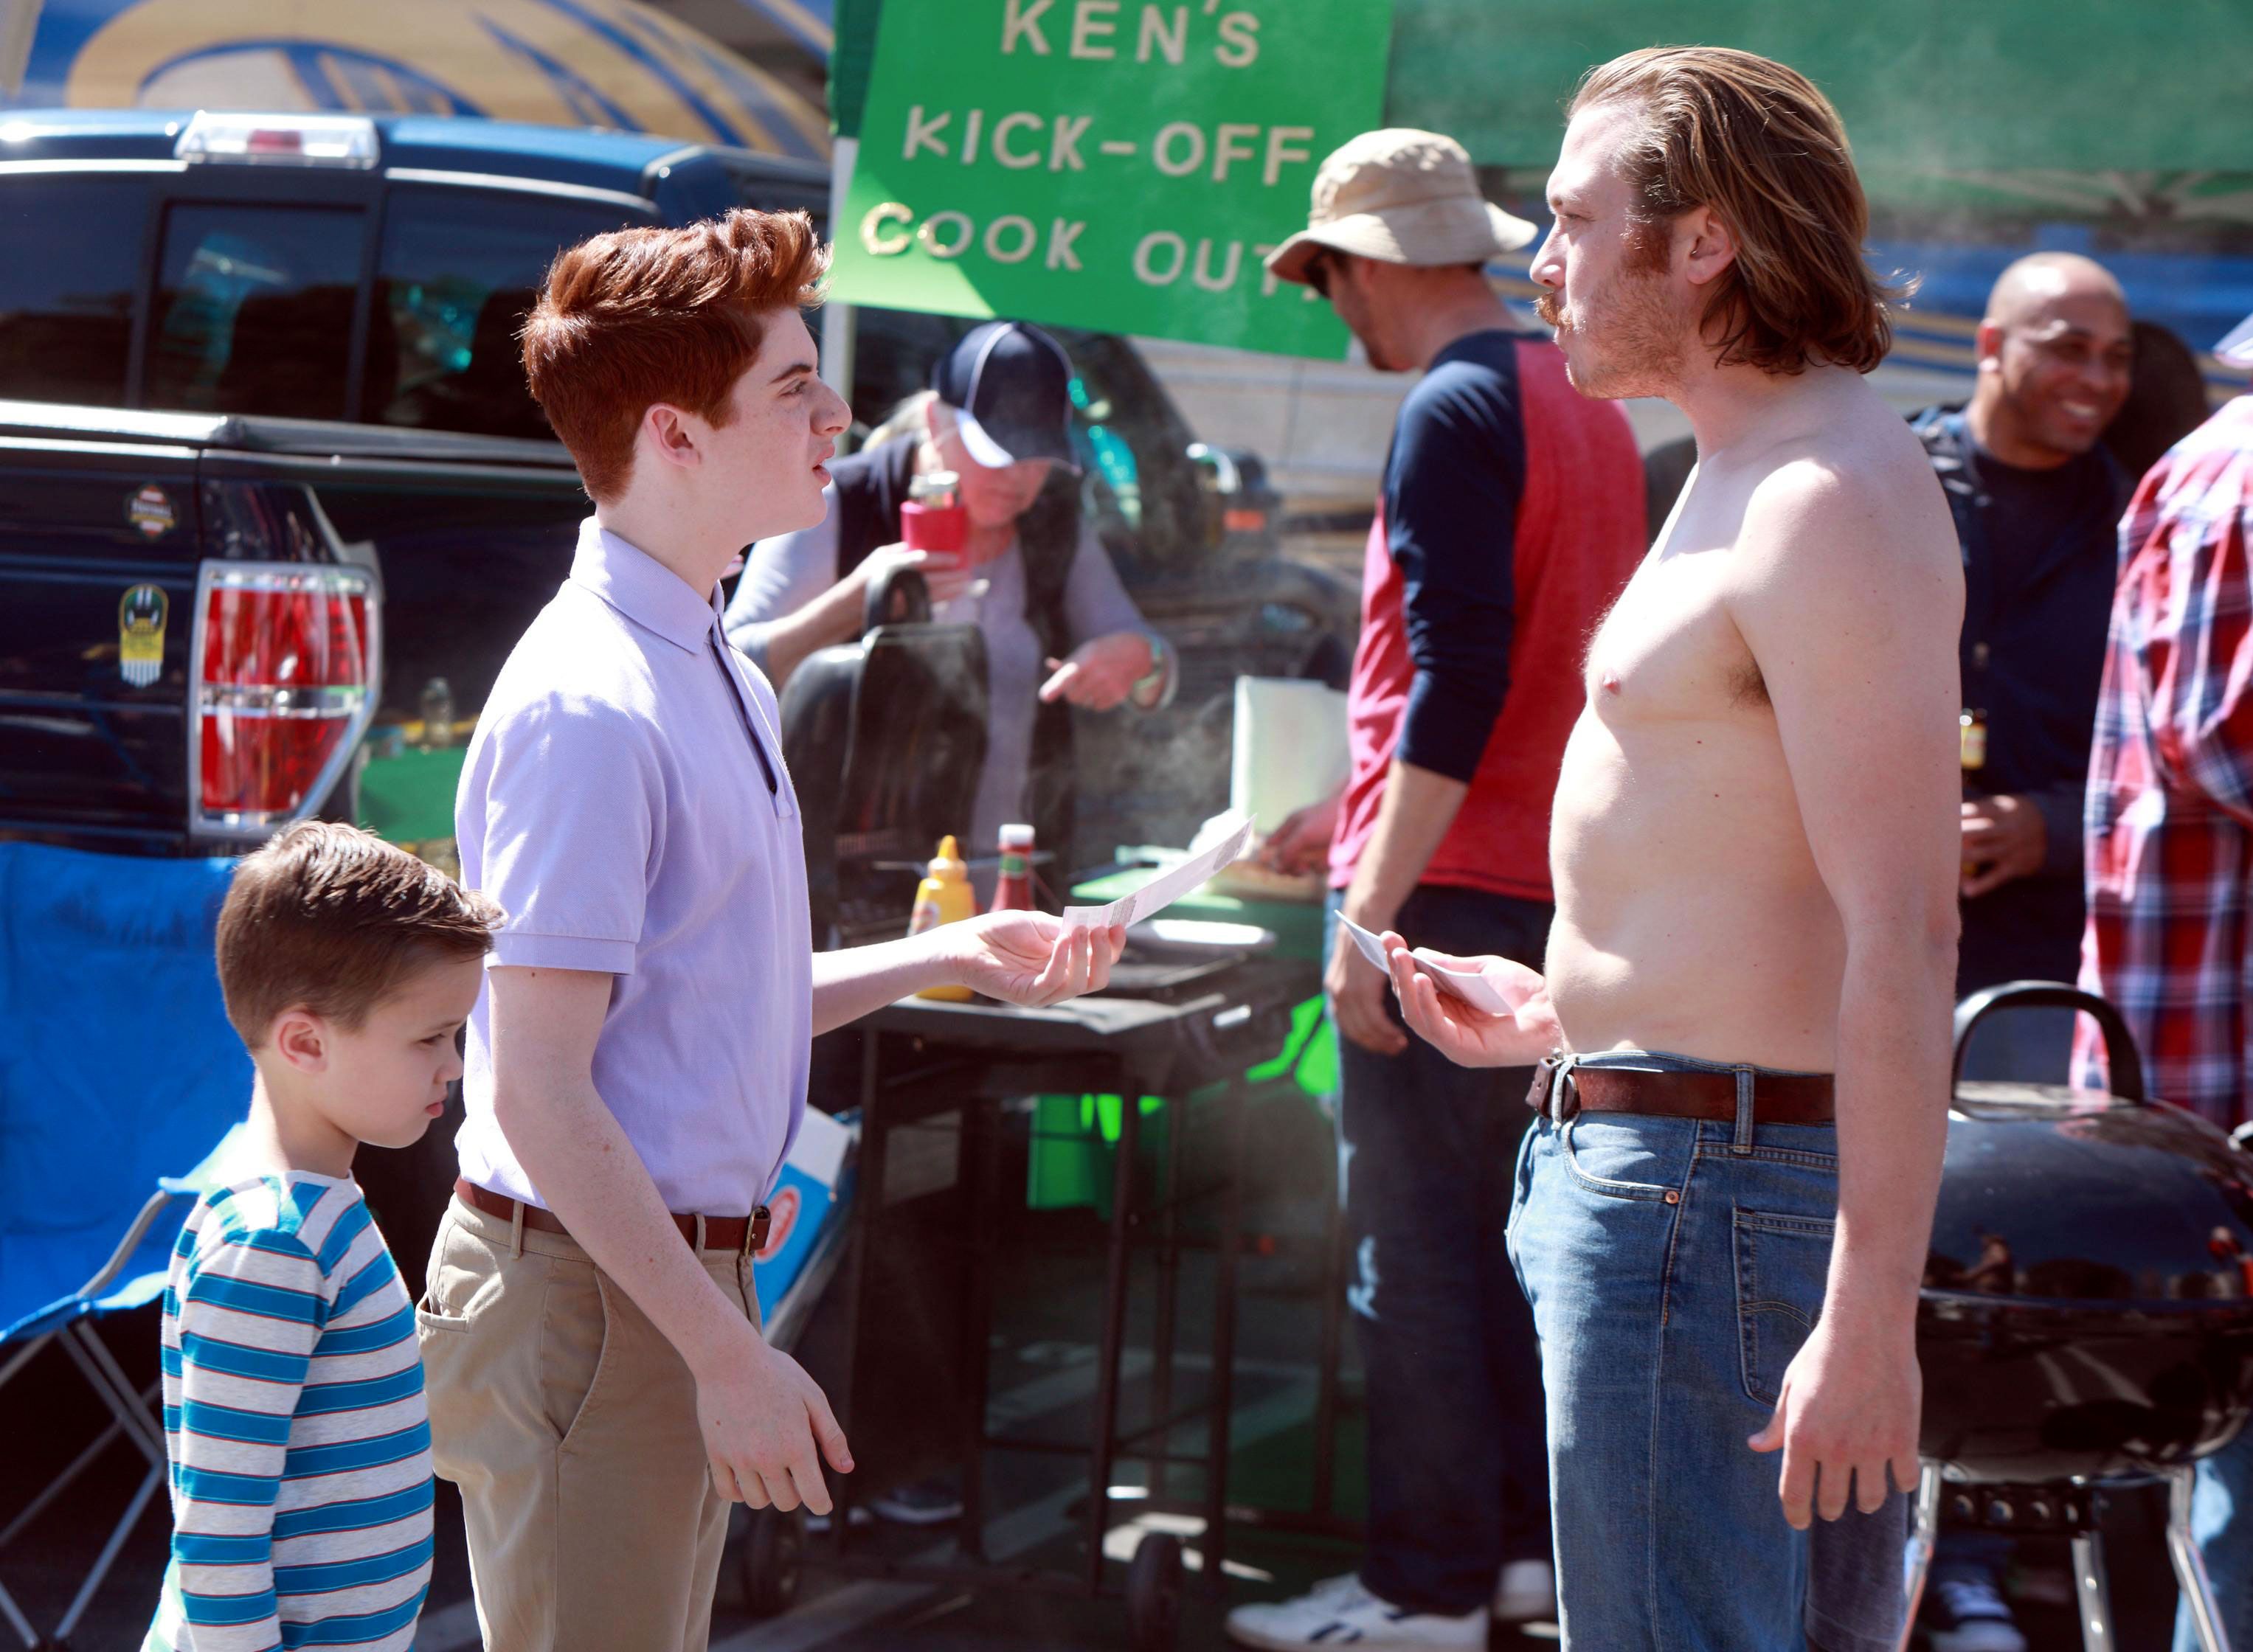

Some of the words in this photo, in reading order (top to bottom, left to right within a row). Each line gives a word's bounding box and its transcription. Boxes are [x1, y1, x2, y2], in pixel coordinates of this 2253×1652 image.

[1001, 0, 1260, 67] KEN'S
[902, 105, 1315, 186] KICK-OFF
[859, 201, 1087, 271] COOK
